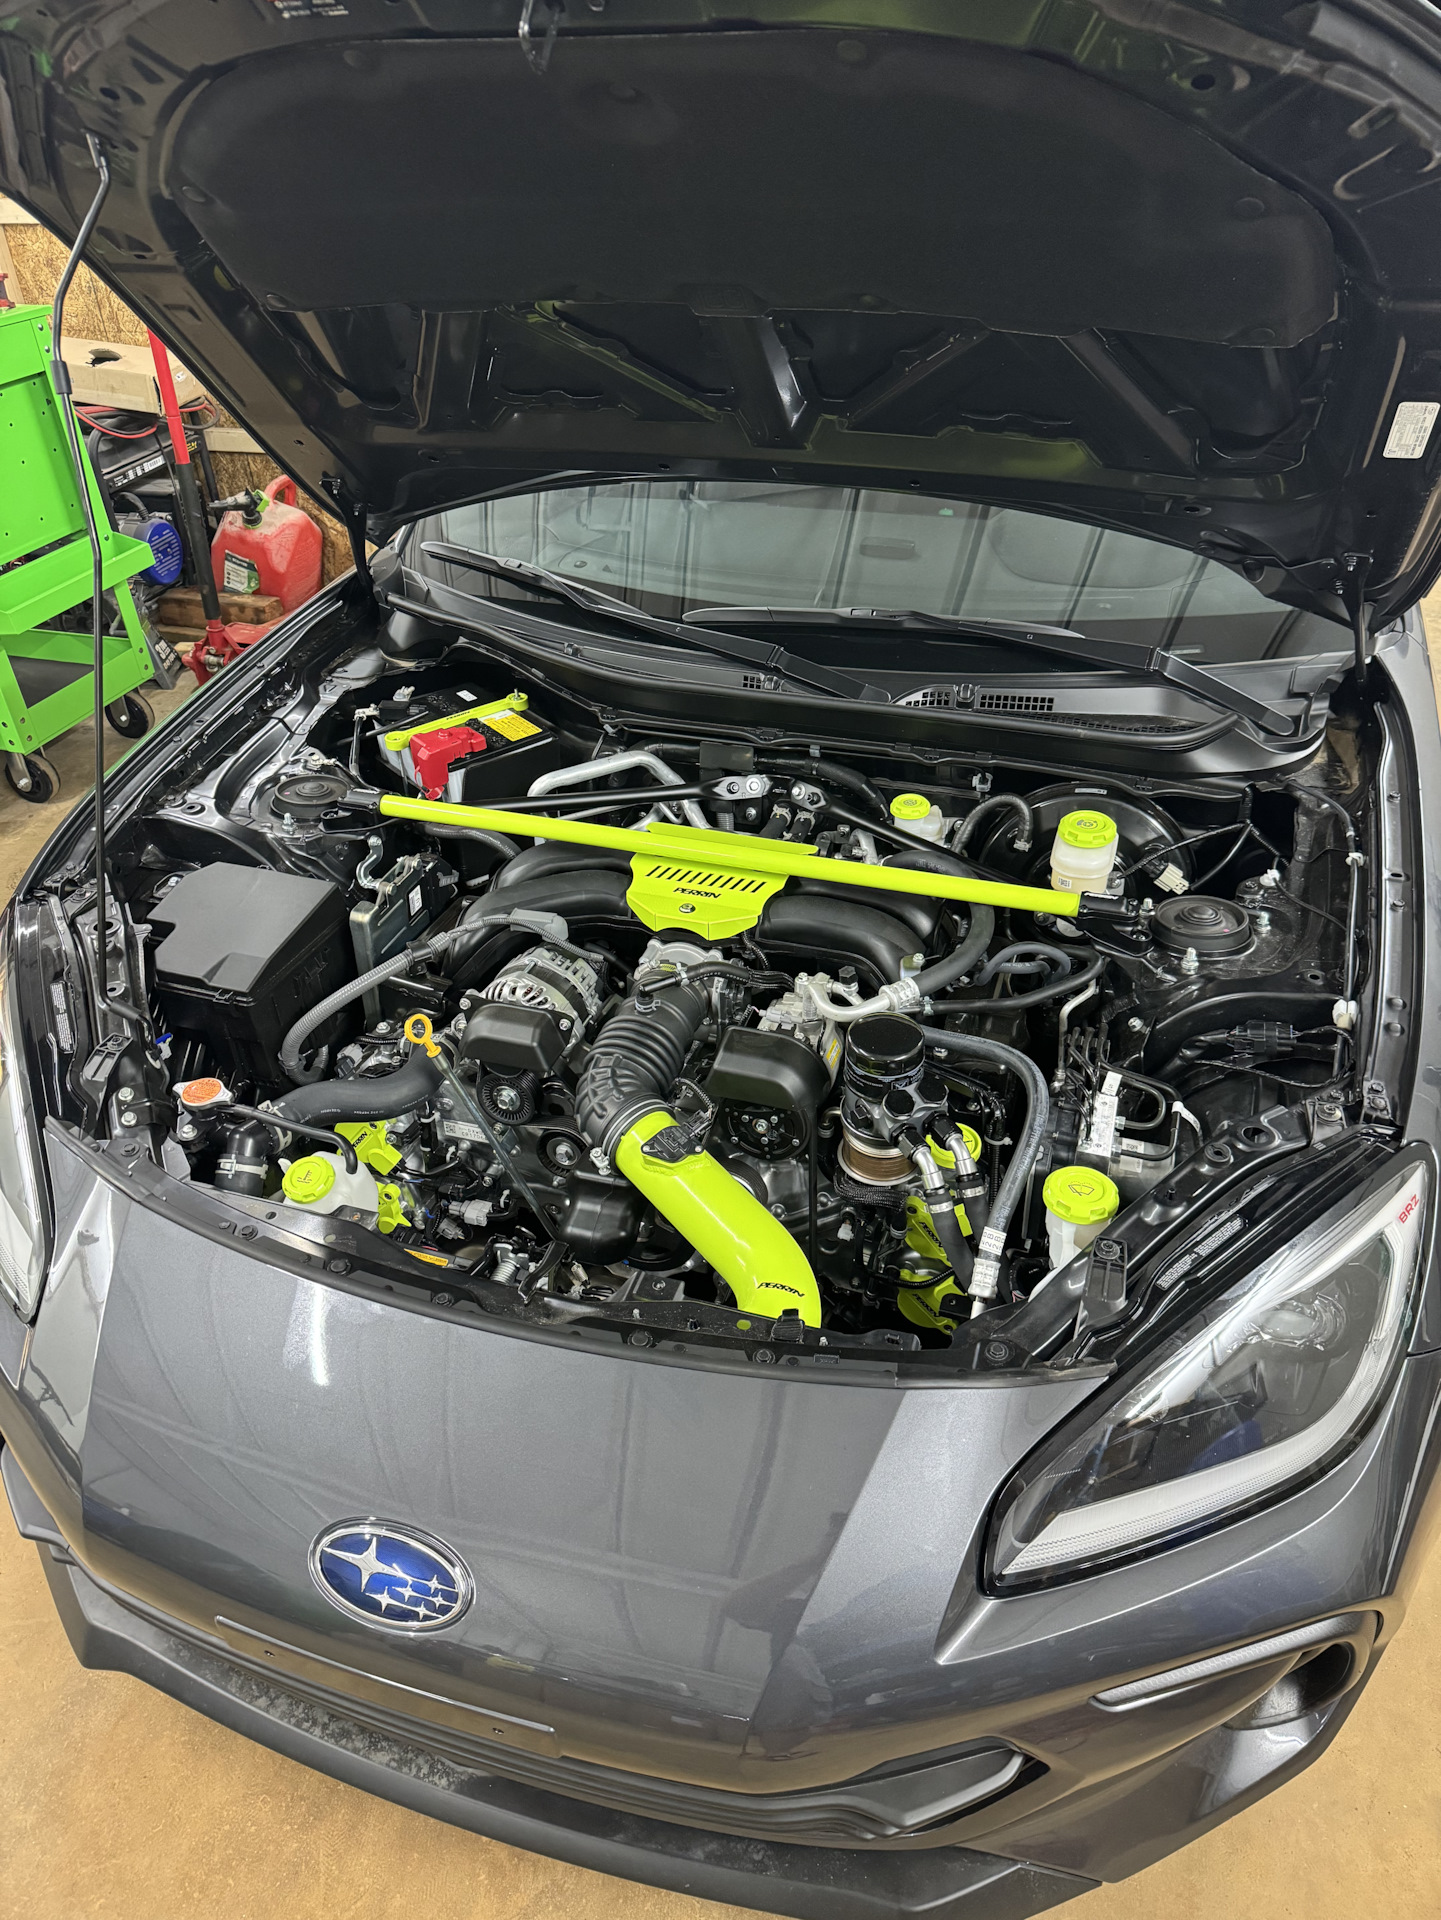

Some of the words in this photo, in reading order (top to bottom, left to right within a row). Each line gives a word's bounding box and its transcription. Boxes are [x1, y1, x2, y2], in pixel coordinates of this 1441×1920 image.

[673, 887, 722, 899] PERRIN
[352, 1131, 368, 1148] ERRIN
[1398, 1193, 1420, 1224] BRZ
[918, 1221, 943, 1248] PERRIN
[756, 1282, 806, 1298] PERRIN
